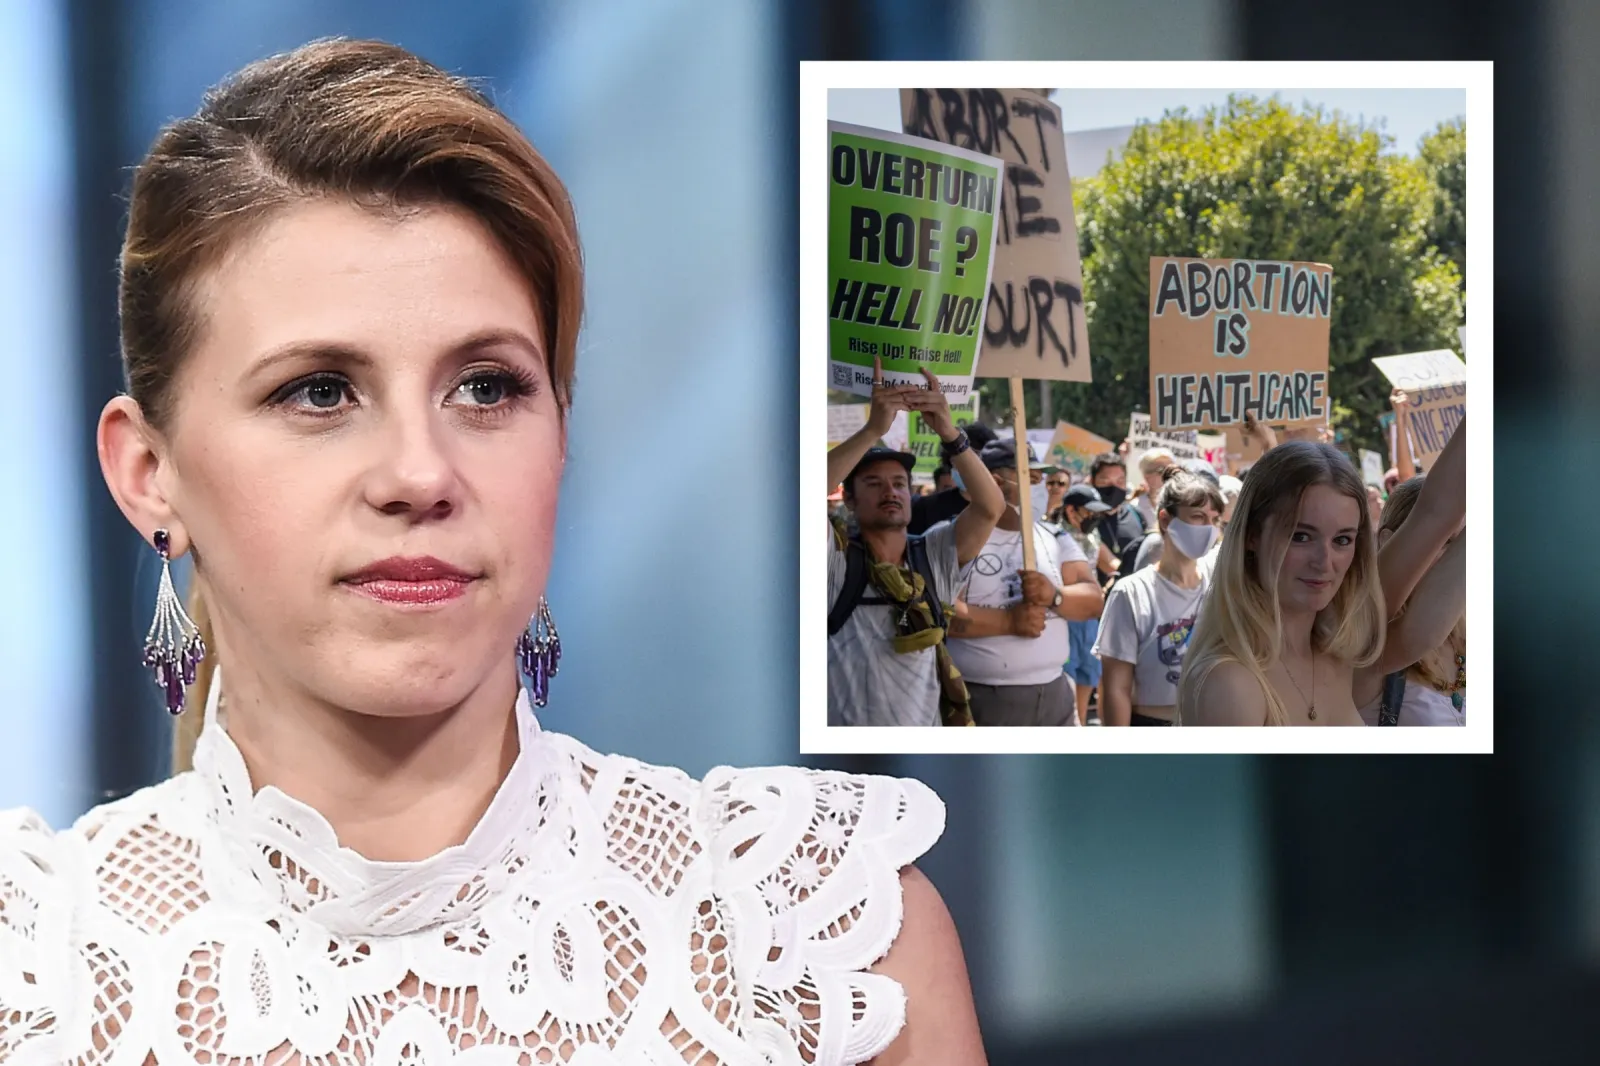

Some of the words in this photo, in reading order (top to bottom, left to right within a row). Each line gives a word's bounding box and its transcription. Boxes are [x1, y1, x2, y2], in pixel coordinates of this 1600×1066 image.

[831, 144, 996, 215] OVERTURN
[849, 206, 943, 273] ROE
[830, 278, 923, 331] HELL
[934, 293, 983, 338] NO!
[1155, 259, 1332, 319] ABORTION
[848, 336, 878, 356] Rise
[882, 341, 905, 361] Up!
[909, 346, 941, 363] Raise
[943, 349, 962, 364] Hell!
[1214, 312, 1251, 359] IS
[1155, 371, 1327, 429] HEALTHCARE
